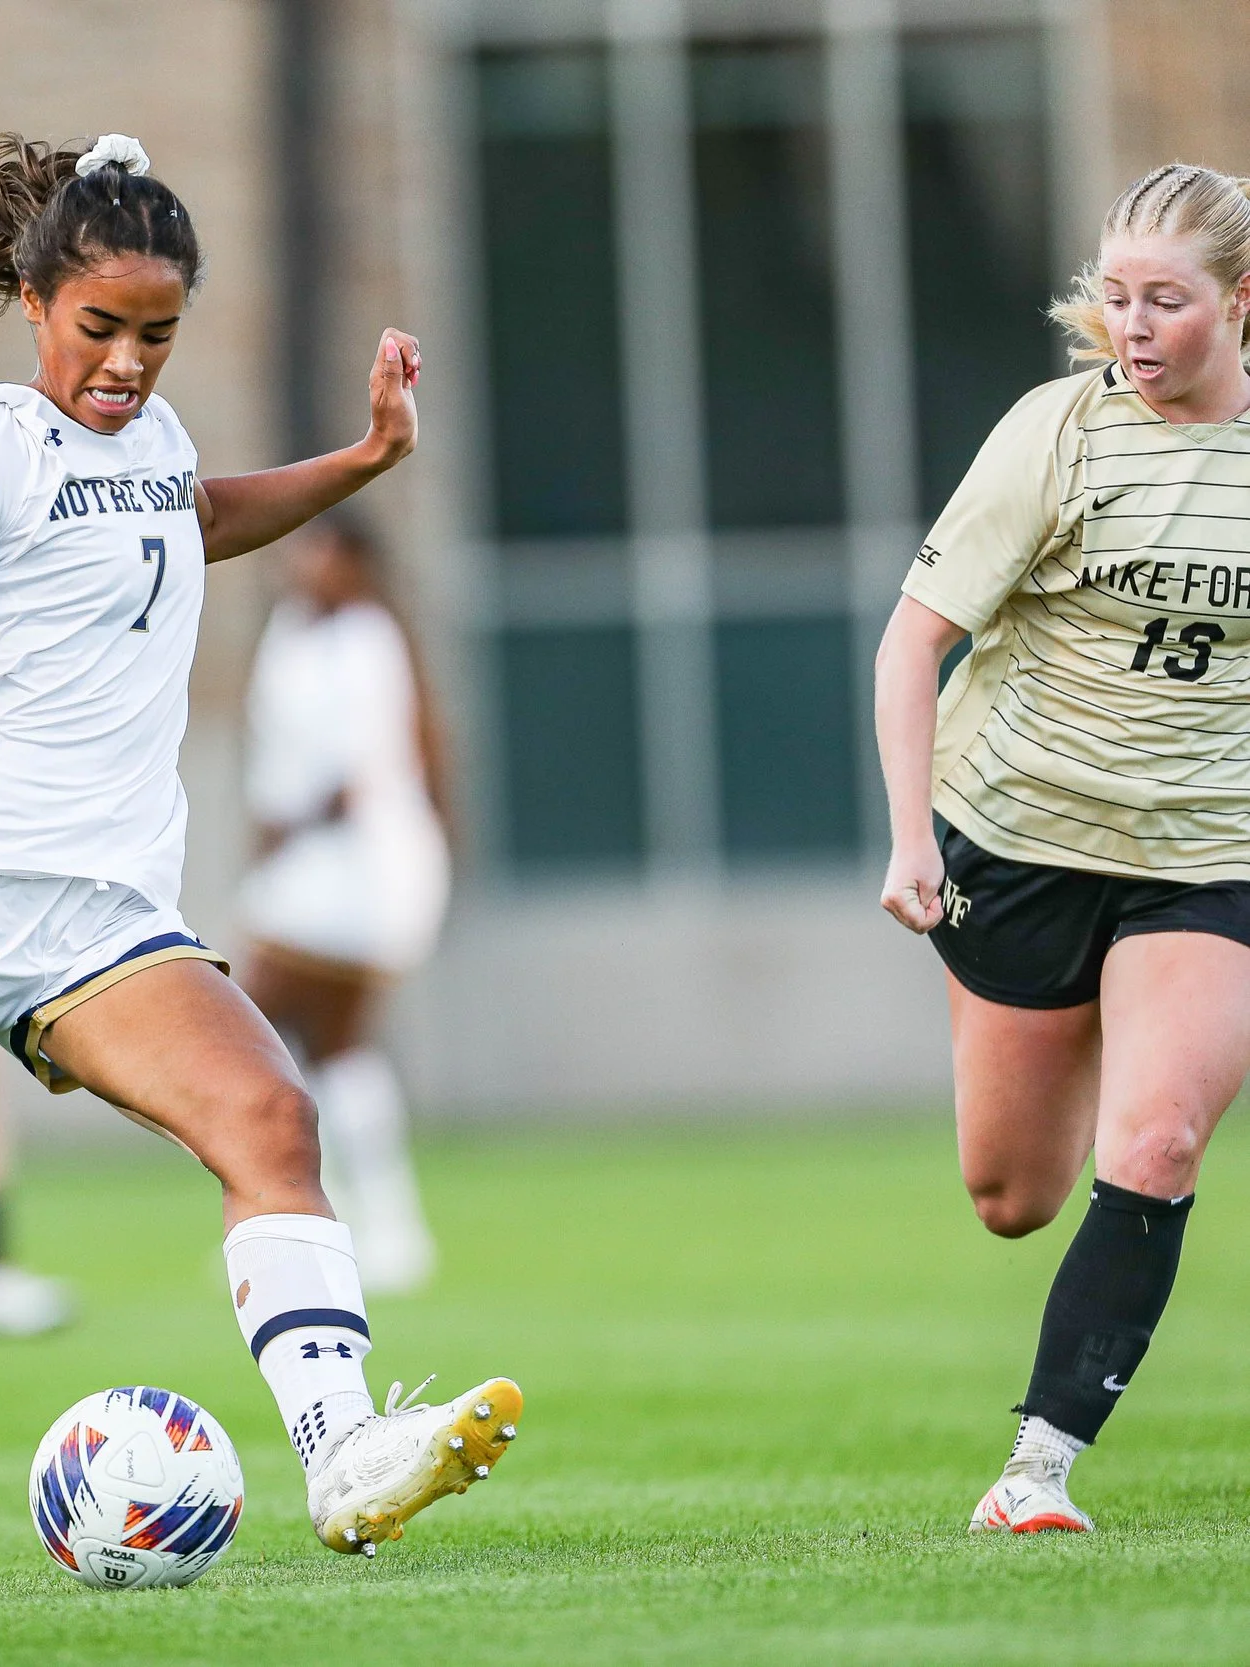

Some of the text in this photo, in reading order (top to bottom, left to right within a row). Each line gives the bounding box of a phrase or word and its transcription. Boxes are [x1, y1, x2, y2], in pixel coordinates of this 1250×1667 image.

[49, 470, 195, 522] NOTRE DAME
[129, 536, 167, 633] 7
[1181, 563, 1250, 609] FOR
[1130, 617, 1226, 682] 13
[100, 1547, 136, 1561] NCAA
